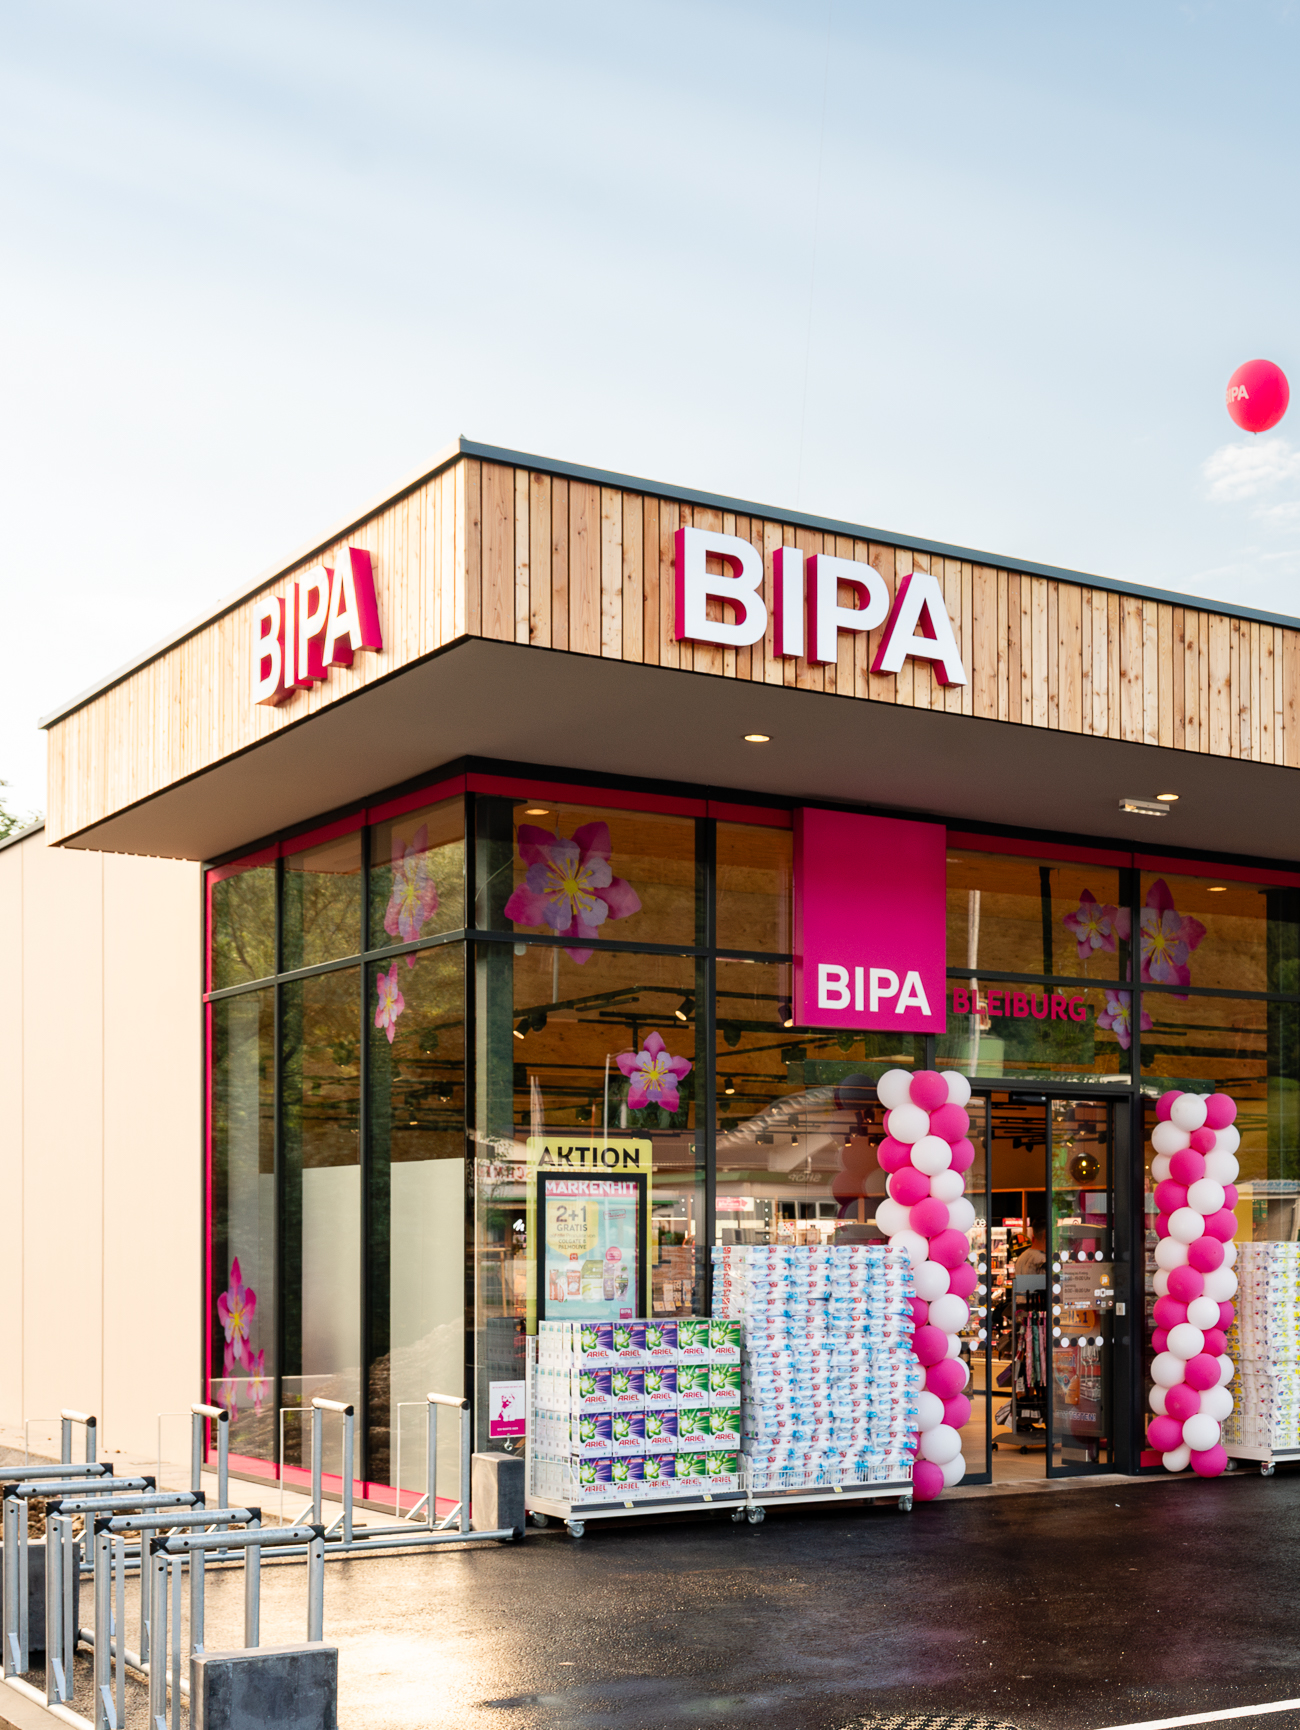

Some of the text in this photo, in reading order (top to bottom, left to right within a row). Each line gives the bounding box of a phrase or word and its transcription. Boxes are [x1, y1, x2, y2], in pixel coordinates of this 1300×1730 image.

[675, 526, 967, 688] BIPA
[253, 546, 382, 707] BIPA
[817, 963, 932, 1016] BIPA
[953, 987, 1087, 1022] BLEIBURG
[538, 1146, 640, 1168] AKTION
[545, 1181, 636, 1195] MARKENHIT
[556, 1205, 587, 1223] 2+1
[556, 1223, 588, 1232] GRATIS
[586, 1350, 609, 1358] ARIEL
[619, 1349, 641, 1357] ARIEL
[651, 1348, 674, 1356] ARIEL
[683, 1347, 704, 1355] ARIEL
[683, 1391, 704, 1399] ARIEL
[584, 1440, 607, 1448] ARIEL
